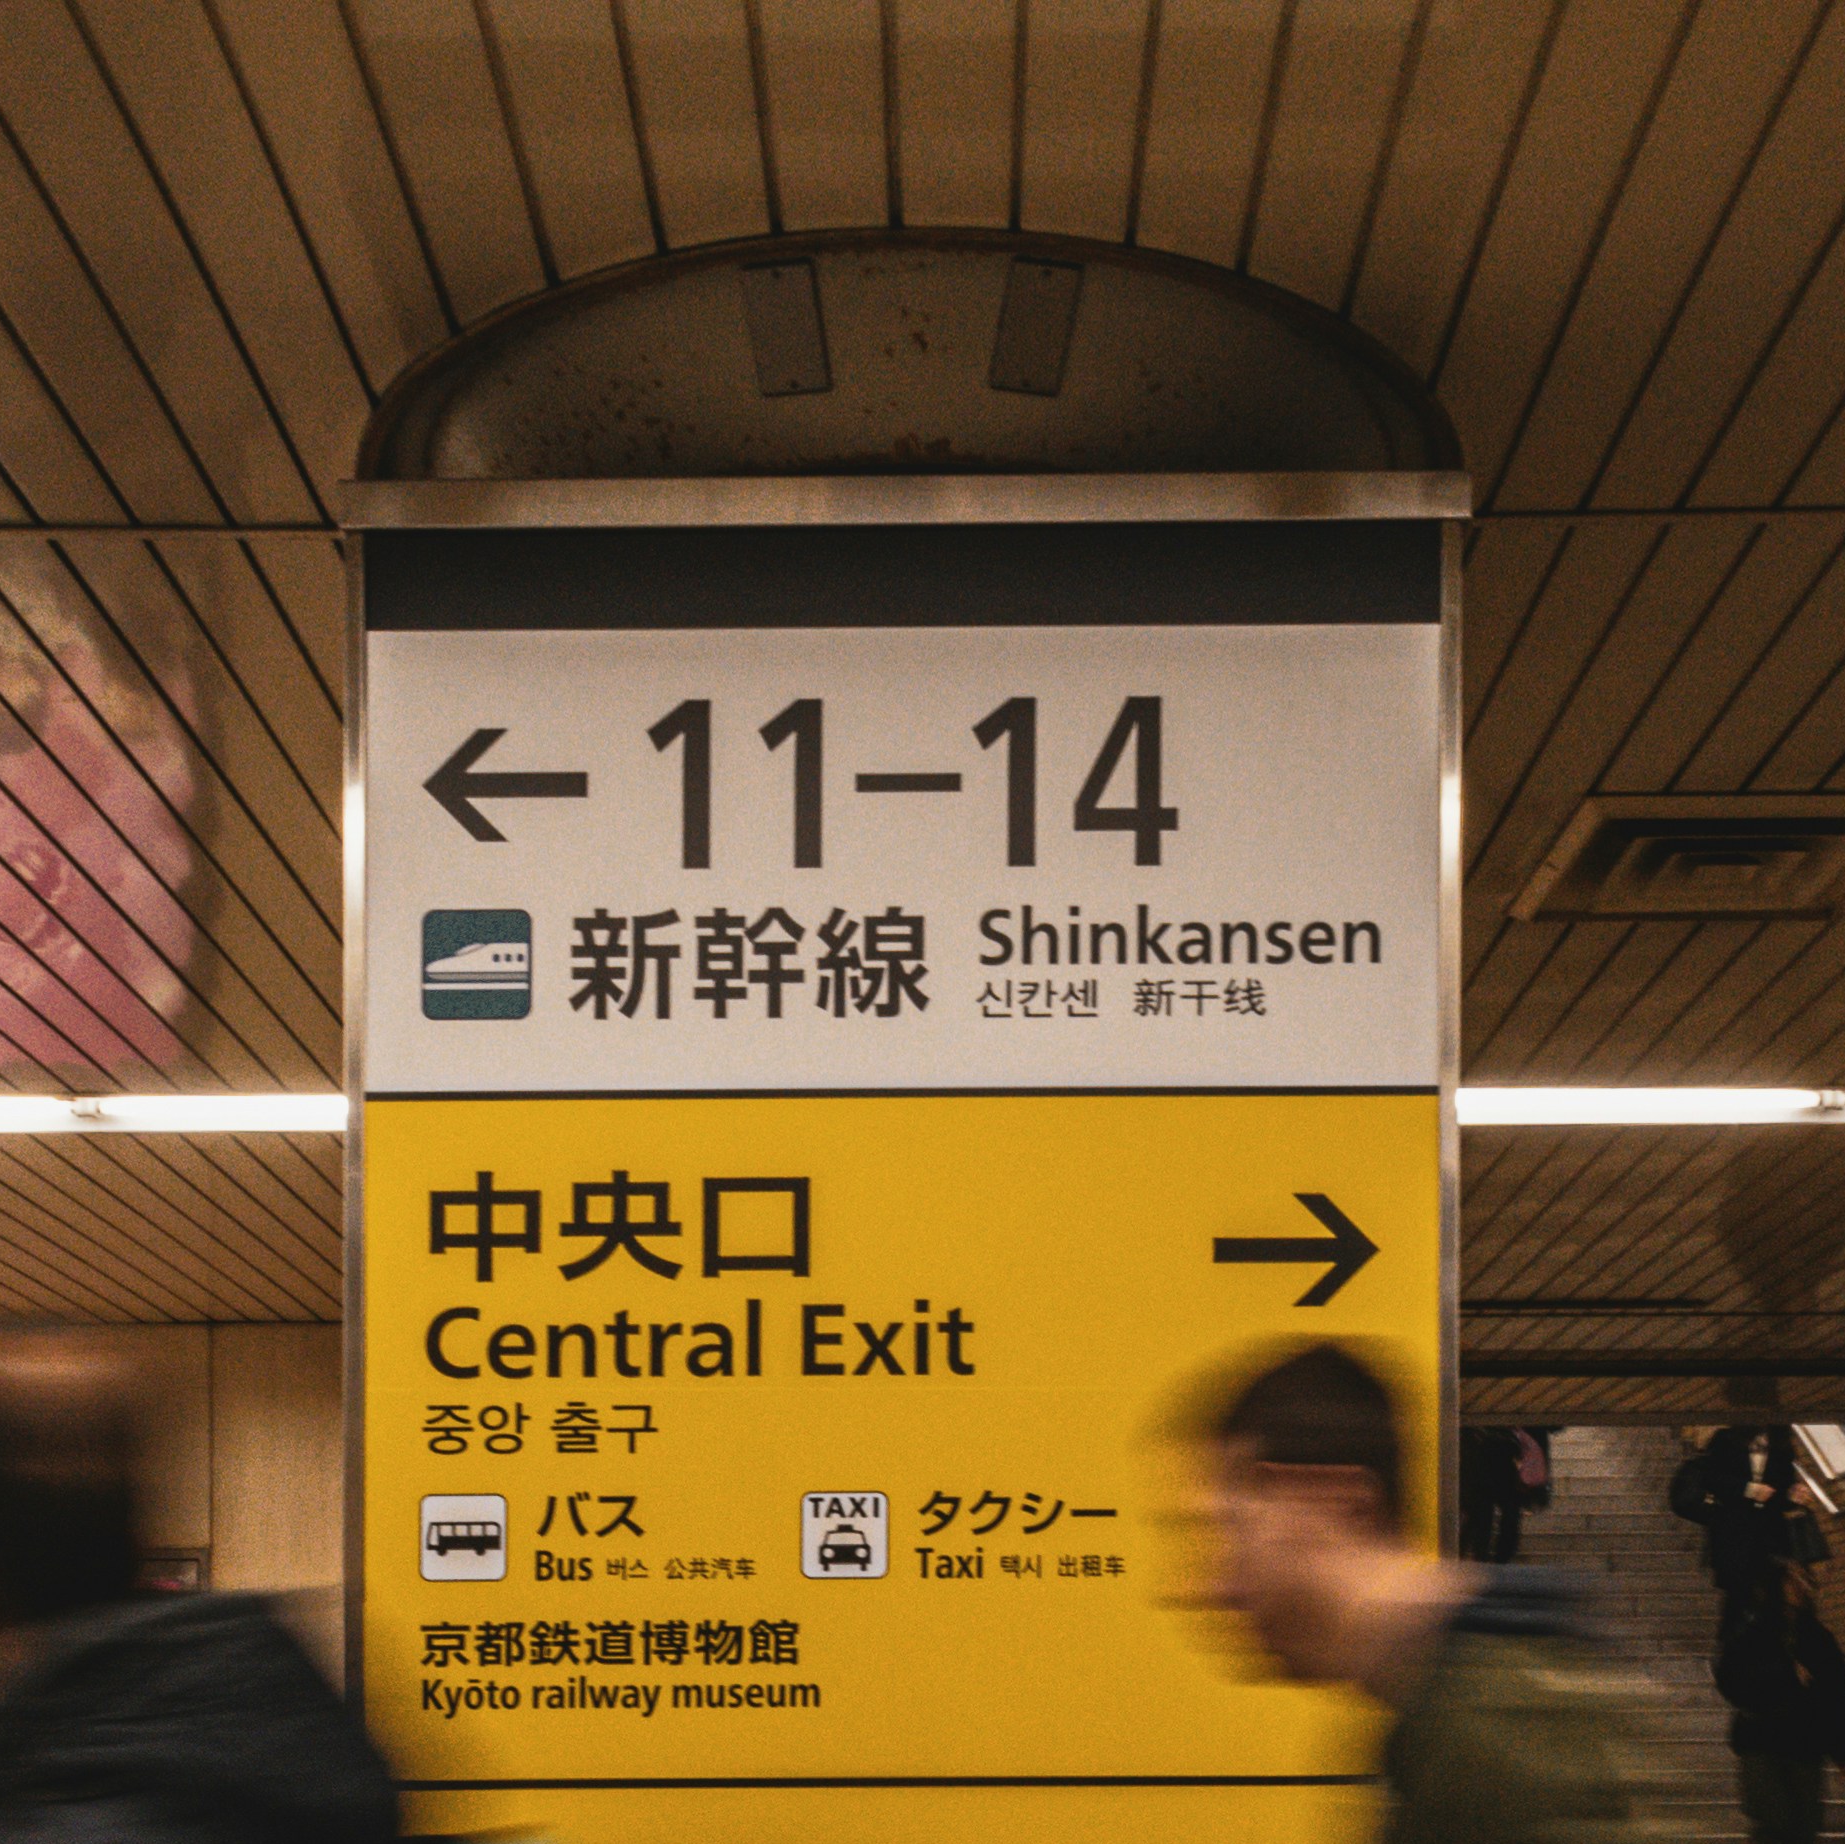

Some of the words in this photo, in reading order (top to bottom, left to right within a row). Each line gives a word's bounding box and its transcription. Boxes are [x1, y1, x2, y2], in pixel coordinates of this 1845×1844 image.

[977, 906, 1383, 966] Shinkansen
[568, 906, 931, 1020] 新幹線
[976, 979, 1100, 1020] 신칸센
[1133, 978, 1266, 1018] 新干线
[426, 1170, 812, 1282] 中央口
[424, 1299, 762, 1379] Central
[800, 1303, 976, 1378] Exit
[422, 1403, 530, 1456] 중앙
[550, 1403, 659, 1456] 출구
[537, 1492, 645, 1537] バス
[809, 1498, 880, 1518] TAXI
[919, 1490, 1117, 1536] タクシー
[535, 1550, 592, 1581] Bus
[607, 1557, 648, 1580] 버스
[665, 1557, 756, 1580] 公共汽车
[915, 1547, 983, 1579] Taxi
[1000, 1554, 1042, 1578] 택시
[1058, 1554, 1125, 1578] 出租车
[420, 1620, 800, 1667] 京都鉄道博物館
[421, 1678, 520, 1719] Kyōto
[532, 1676, 661, 1717] railway
[672, 1683, 821, 1712] museum
